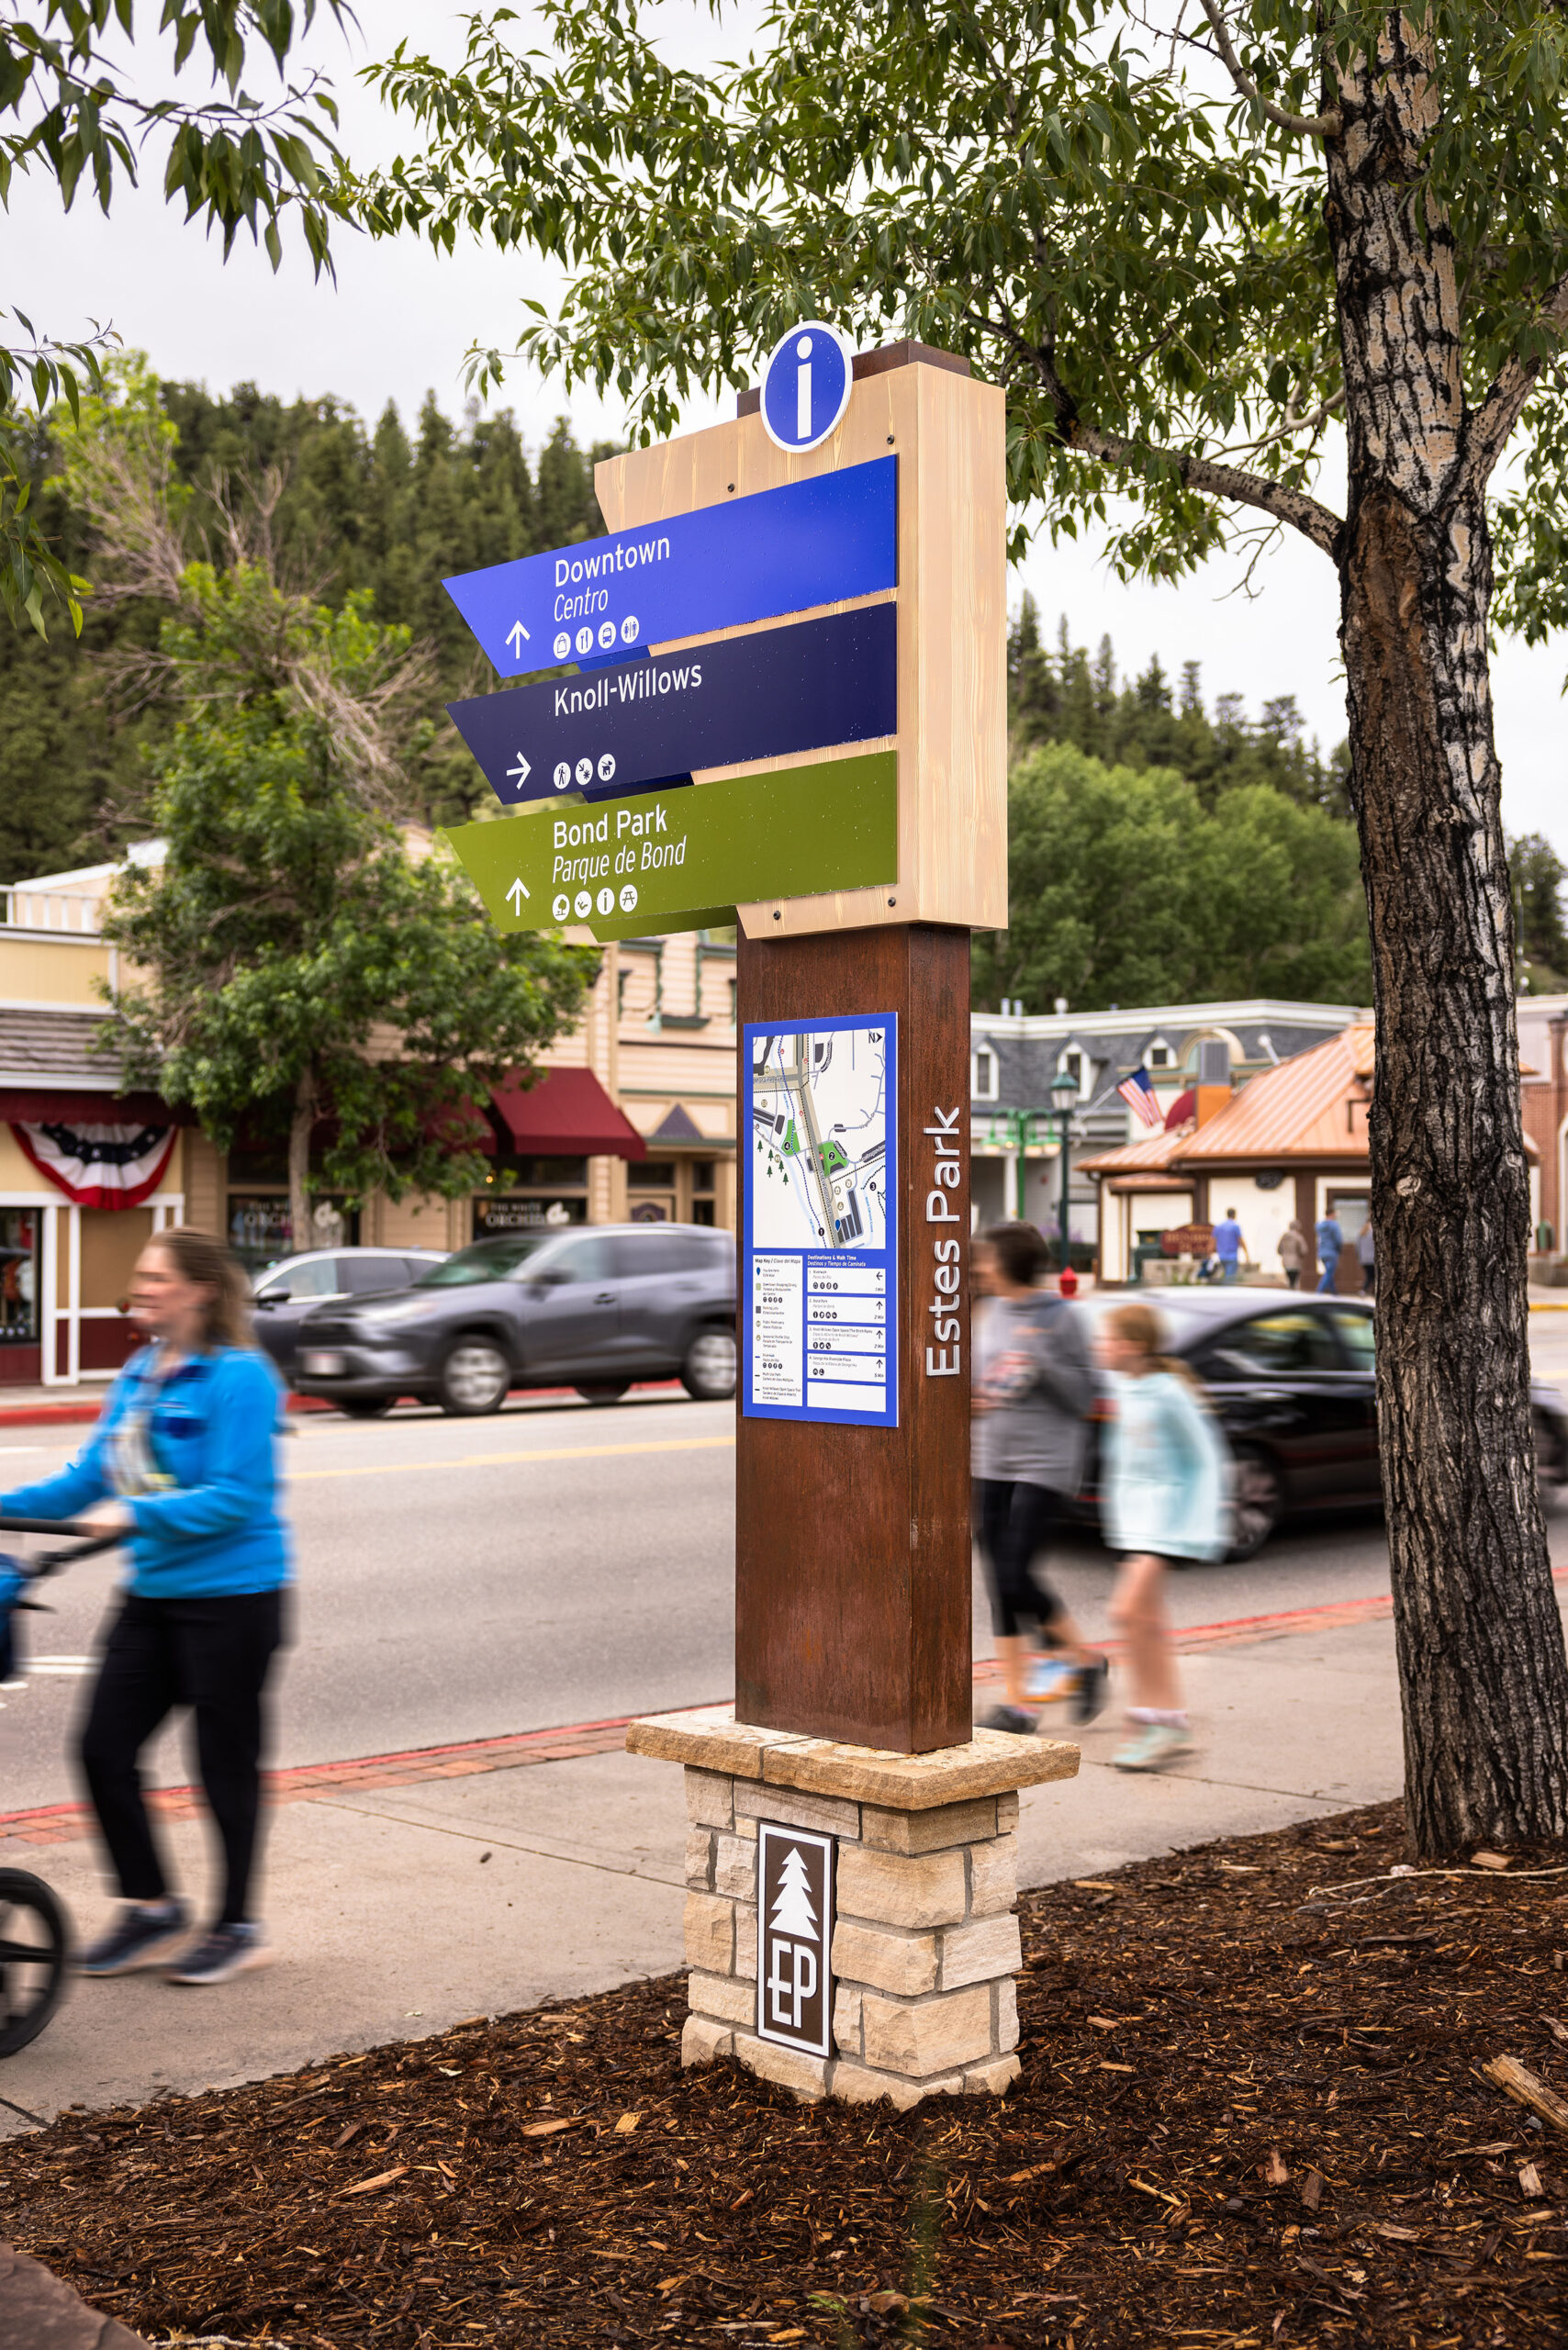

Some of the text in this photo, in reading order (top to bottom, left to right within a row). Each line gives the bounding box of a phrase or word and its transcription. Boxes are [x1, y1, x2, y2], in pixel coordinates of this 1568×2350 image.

[555, 537, 670, 588] Downtown
[554, 587, 609, 622] Centro
[554, 665, 702, 717] Knoll-Willows
[554, 803, 667, 849] Bond Park
[553, 834, 687, 886] Parque de Bond
[868, 1033, 876, 1044] N
[924, 1106, 960, 1376] Estes Park
[767, 1938, 817, 2029] EP
